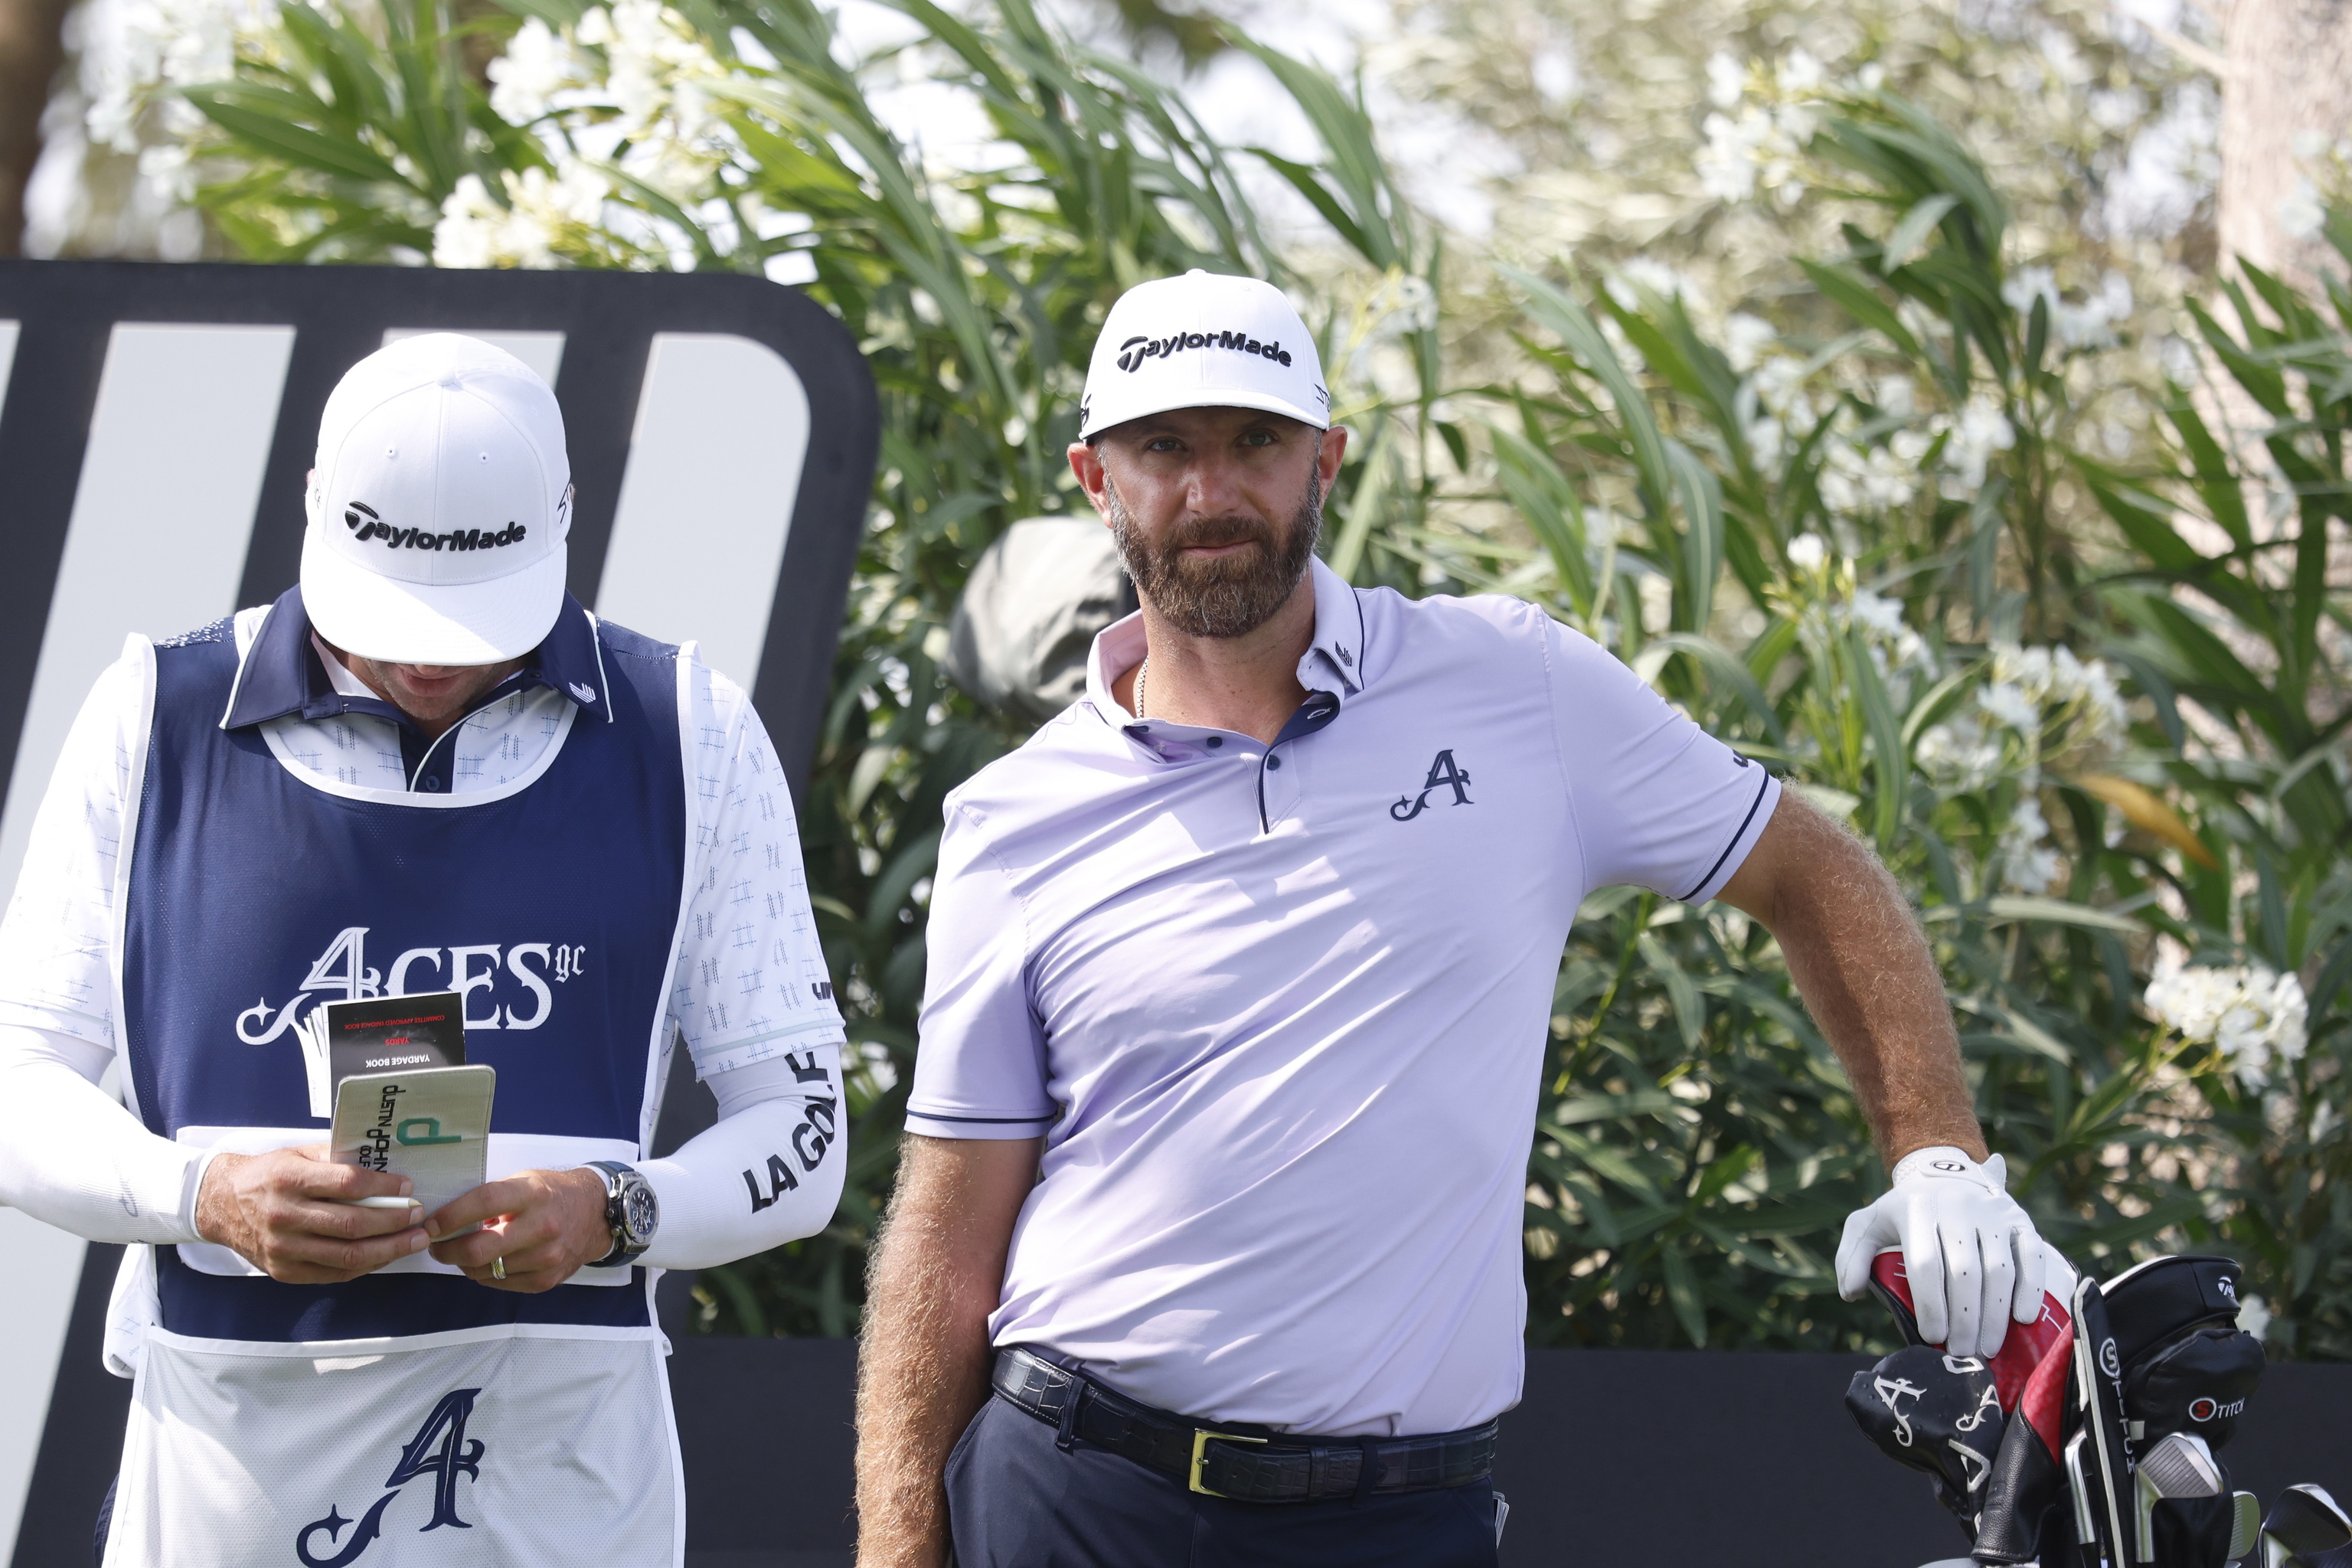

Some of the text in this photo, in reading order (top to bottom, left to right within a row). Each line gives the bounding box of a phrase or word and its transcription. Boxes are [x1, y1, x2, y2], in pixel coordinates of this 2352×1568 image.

[1117, 331, 1292, 373] TaylorMade
[345, 501, 526, 551] TaylorMade
[414, 1014, 445, 1023] COMMITTEE
[365, 1054, 430, 1068] YARDAGE BOOK
[385, 1037, 410, 1046] YARDS
[743, 1154, 799, 1214] LA
[2099, 1338, 2136, 1475] STITCH
